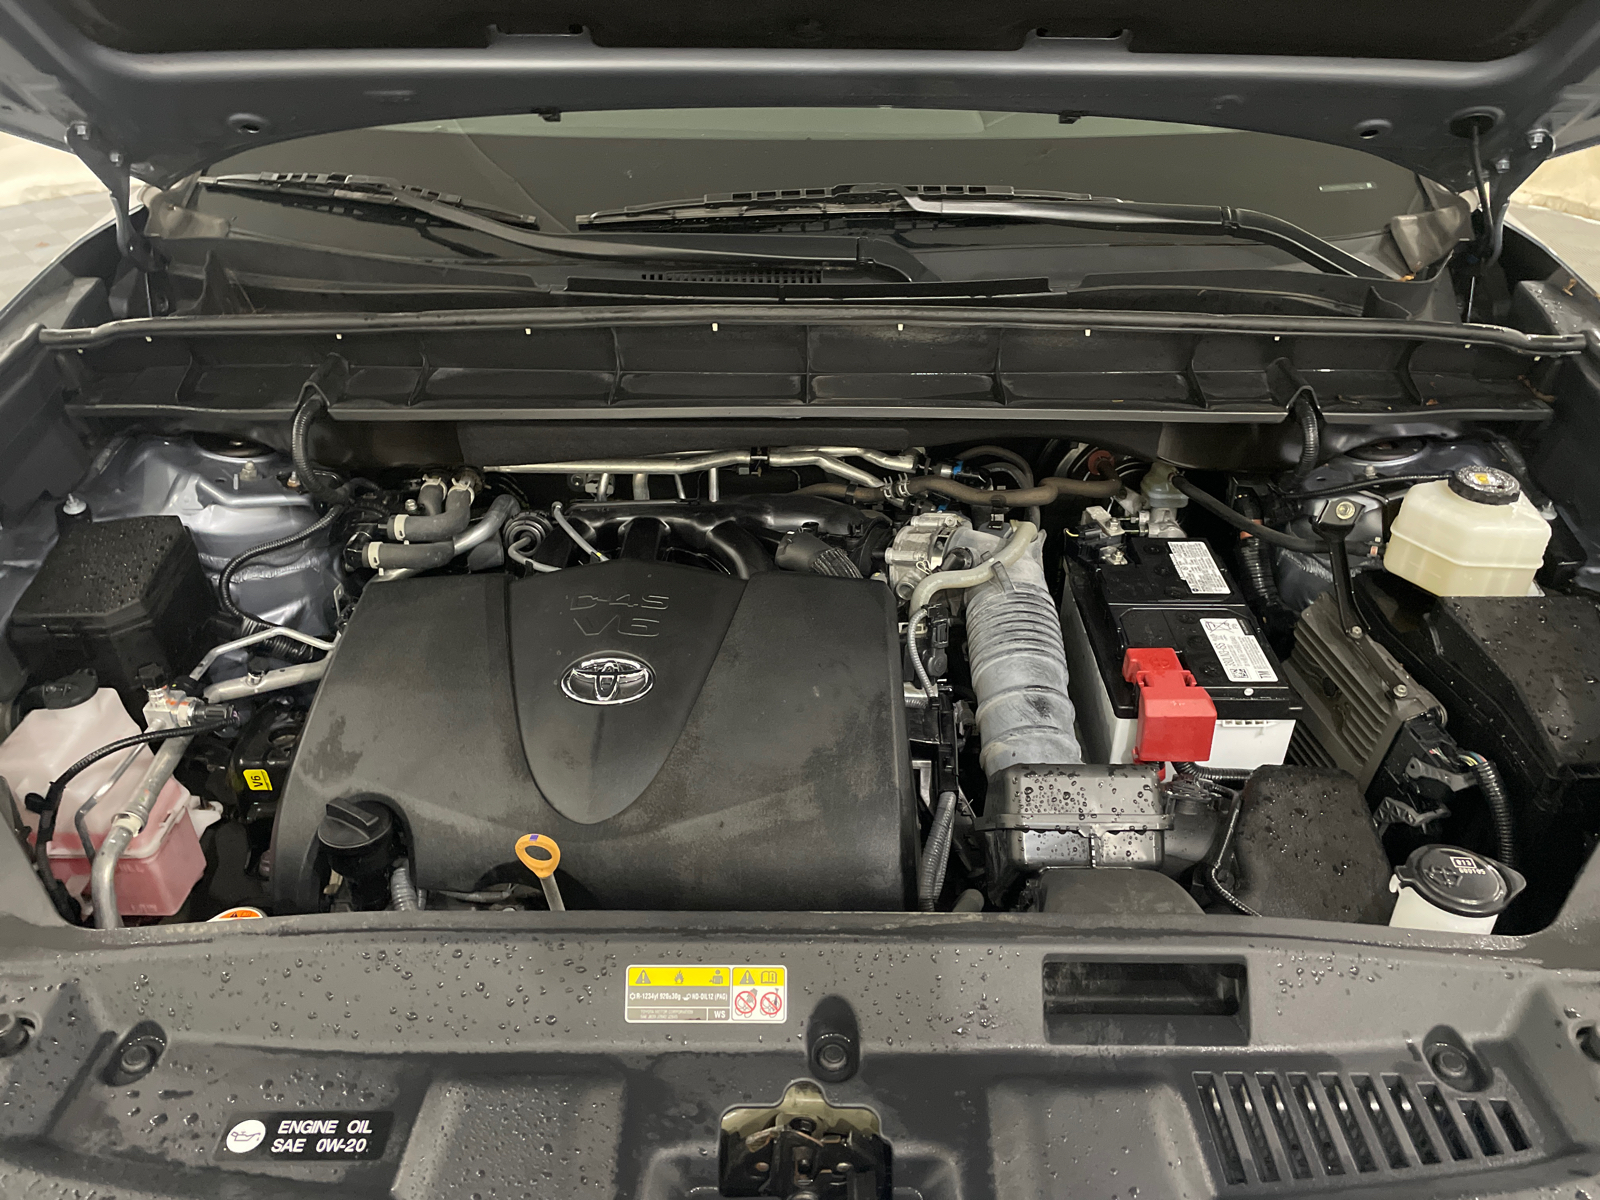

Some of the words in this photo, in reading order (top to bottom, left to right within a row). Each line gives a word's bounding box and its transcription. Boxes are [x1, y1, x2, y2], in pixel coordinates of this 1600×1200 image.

[573, 613, 661, 638] V6
[250, 775, 263, 787] V6
[714, 992, 728, 1002] (PAG)
[277, 1119, 339, 1134] ENGINE
[346, 1119, 373, 1134] OIL
[270, 1138, 307, 1153] SAE
[315, 1138, 367, 1153] 0W-20
